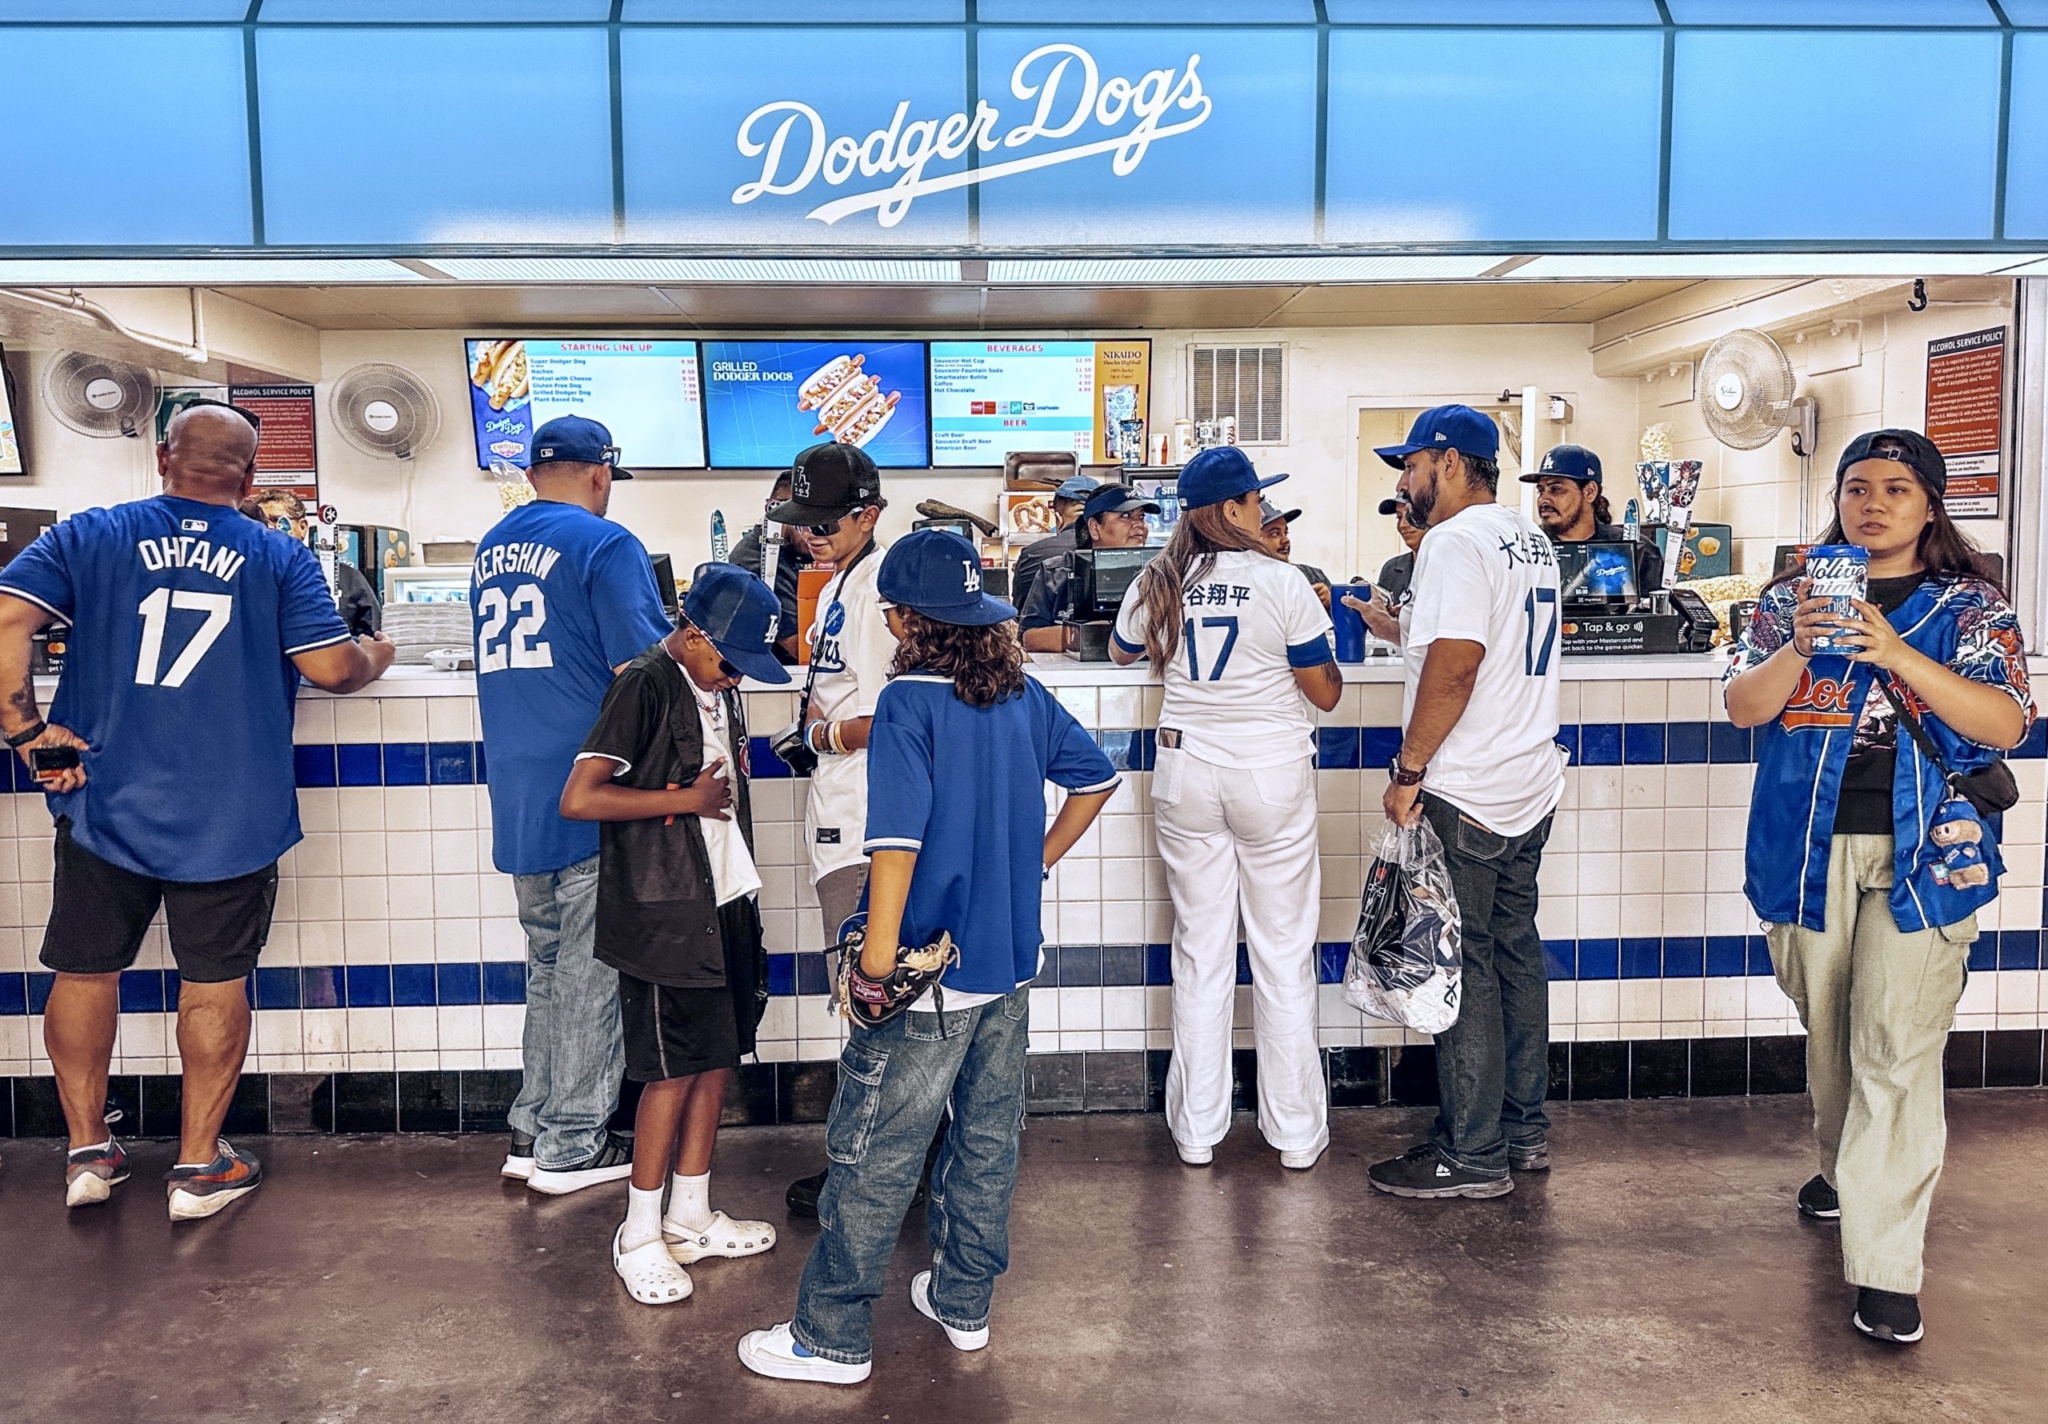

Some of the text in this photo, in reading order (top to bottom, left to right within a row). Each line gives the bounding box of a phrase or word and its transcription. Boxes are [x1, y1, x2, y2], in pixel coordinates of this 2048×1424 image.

[731, 43, 1212, 227] Dodger Dogs
[560, 343, 652, 351] STARTING LINE UP
[987, 344, 1043, 352] BEVERAGES
[1930, 331, 2002, 353] ALCOHOL SERVICE POLICY
[713, 362, 757, 372] GRILLED
[713, 372, 793, 381] DODGER DOGS
[289, 387, 311, 395] POLICY
[138, 536, 246, 583] OHTANI
[474, 542, 561, 589] KERSHAW
[1498, 529, 1557, 570] 大谷翔
[1182, 583, 1250, 607] 谷翔平
[135, 586, 233, 688] 17
[478, 583, 554, 674] 22
[1524, 586, 1557, 675] 17
[1582, 621, 1630, 634] Tap & go
[1184, 615, 1239, 680] 17
